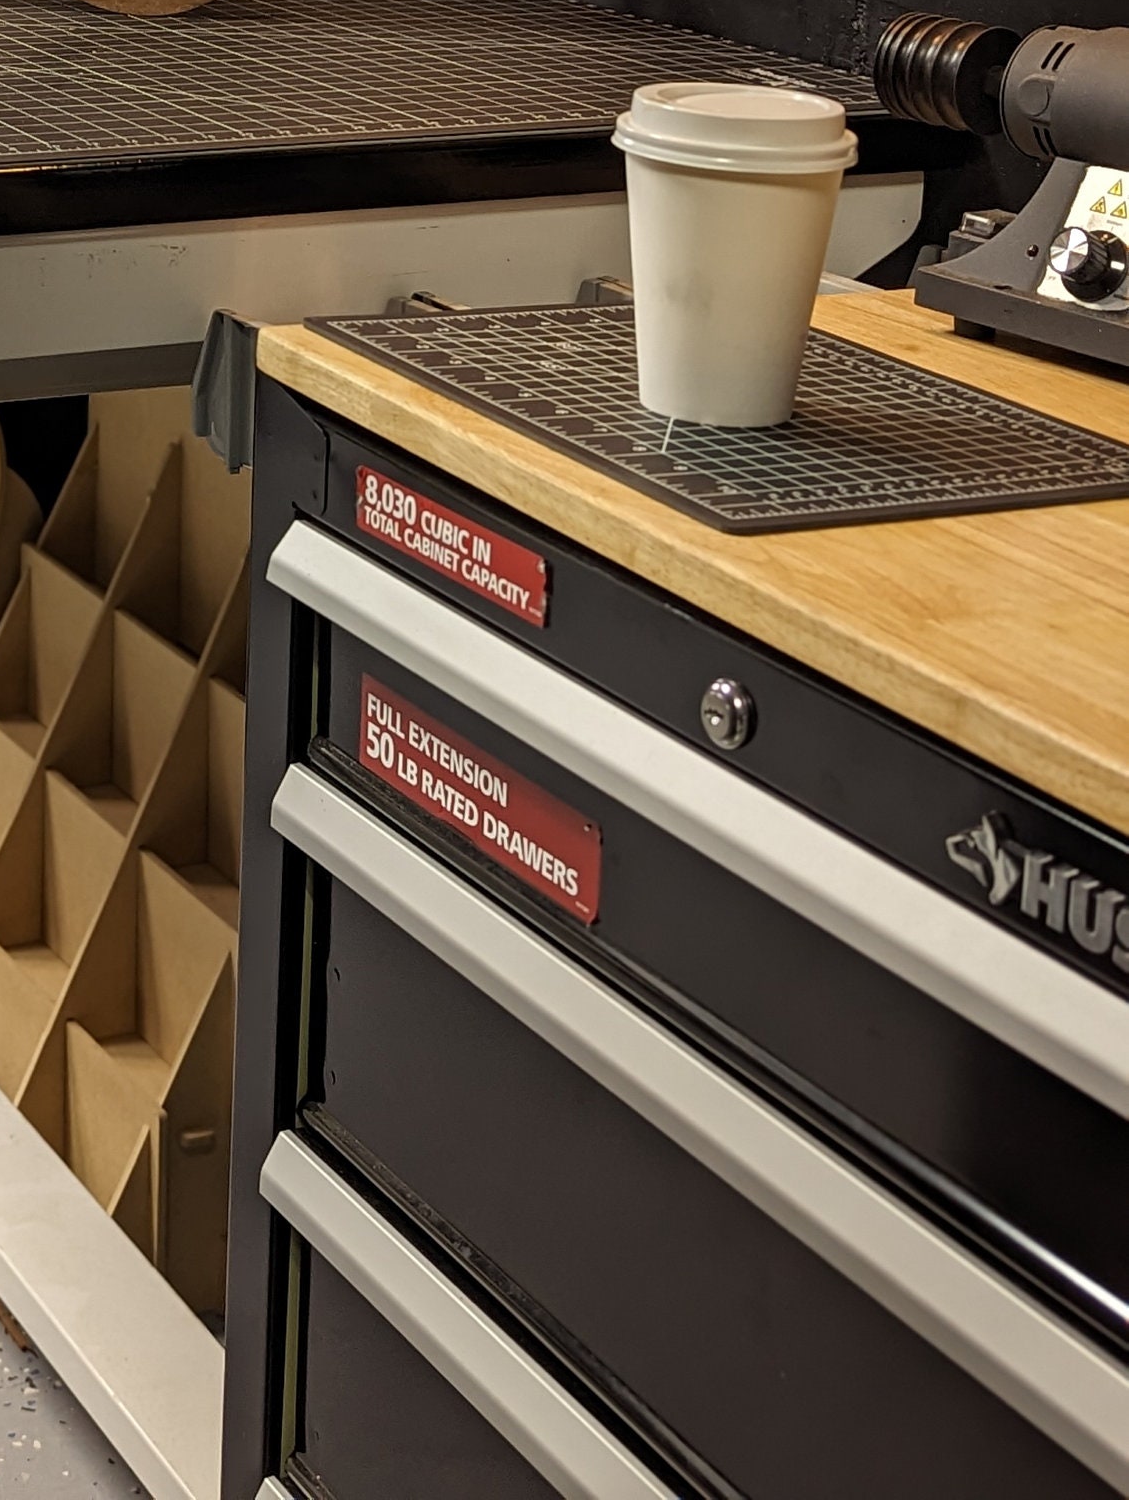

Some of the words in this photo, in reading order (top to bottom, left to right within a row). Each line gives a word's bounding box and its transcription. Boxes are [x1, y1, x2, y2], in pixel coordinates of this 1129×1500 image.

[364, 474, 417, 526] 8,030
[421, 509, 469, 555] CUBIC
[472, 535, 491, 566] IN
[364, 504, 402, 542] TOTAL
[404, 527, 459, 573] CABINET
[462, 556, 530, 610] CAPACITY
[367, 692, 406, 740] FULL
[408, 725, 508, 807] EXTENSION
[366, 725, 394, 769] 50
[397, 752, 418, 787] LB
[421, 772, 479, 828] RATED
[483, 810, 579, 897] DRAWERS
